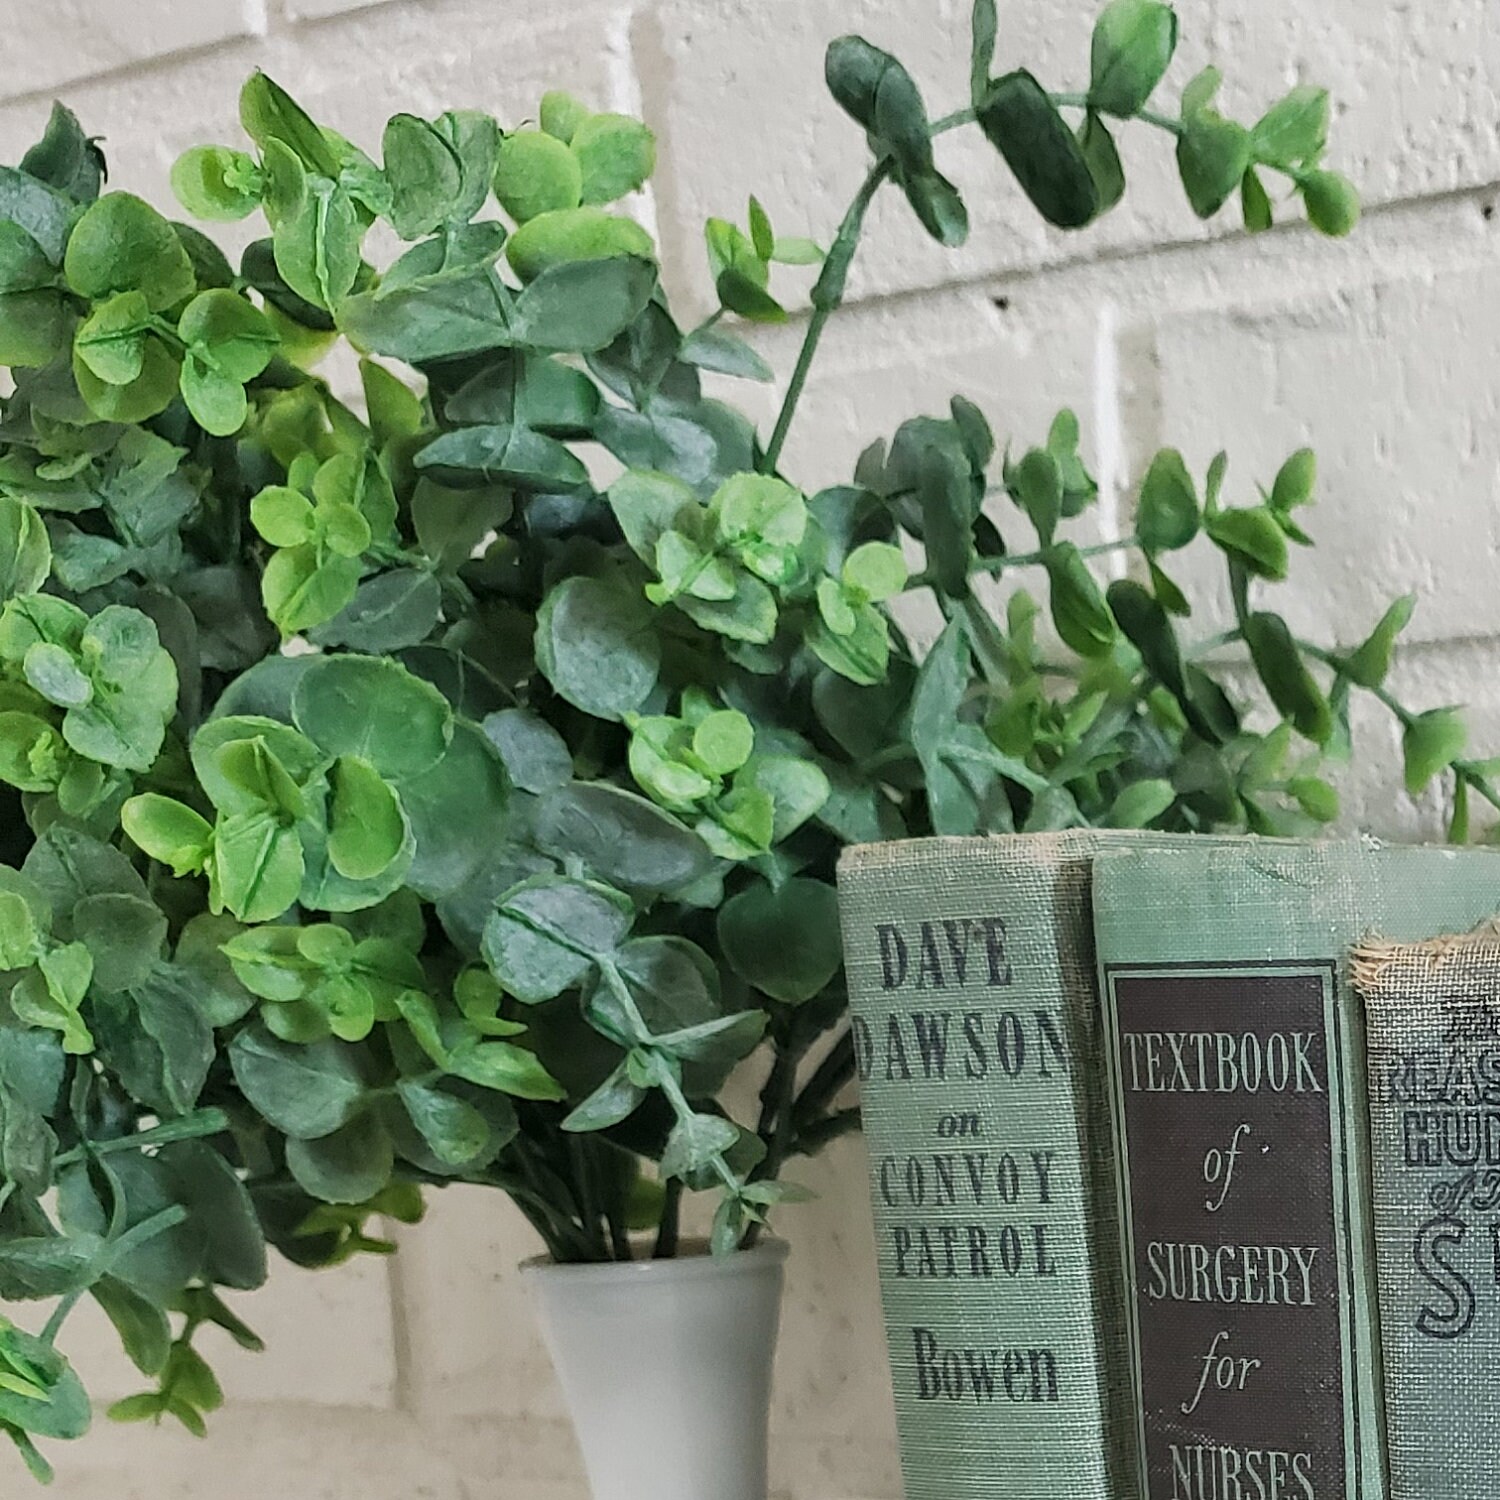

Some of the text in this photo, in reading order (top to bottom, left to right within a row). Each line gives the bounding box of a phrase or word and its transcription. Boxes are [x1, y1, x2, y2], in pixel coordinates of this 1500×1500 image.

[875, 916, 1013, 991] DAVE
[851, 1009, 1072, 1082] DAWSON
[1123, 1031, 1325, 1094] TEXTBOOK
[936, 1108, 982, 1139] on
[880, 1151, 1057, 1207] CONVOY
[1204, 1123, 1250, 1212] of
[892, 1223, 1057, 1278] PATROL
[1146, 1241, 1319, 1306] SURGERY
[912, 1327, 1061, 1405] Bowen
[1181, 1331, 1261, 1415] for
